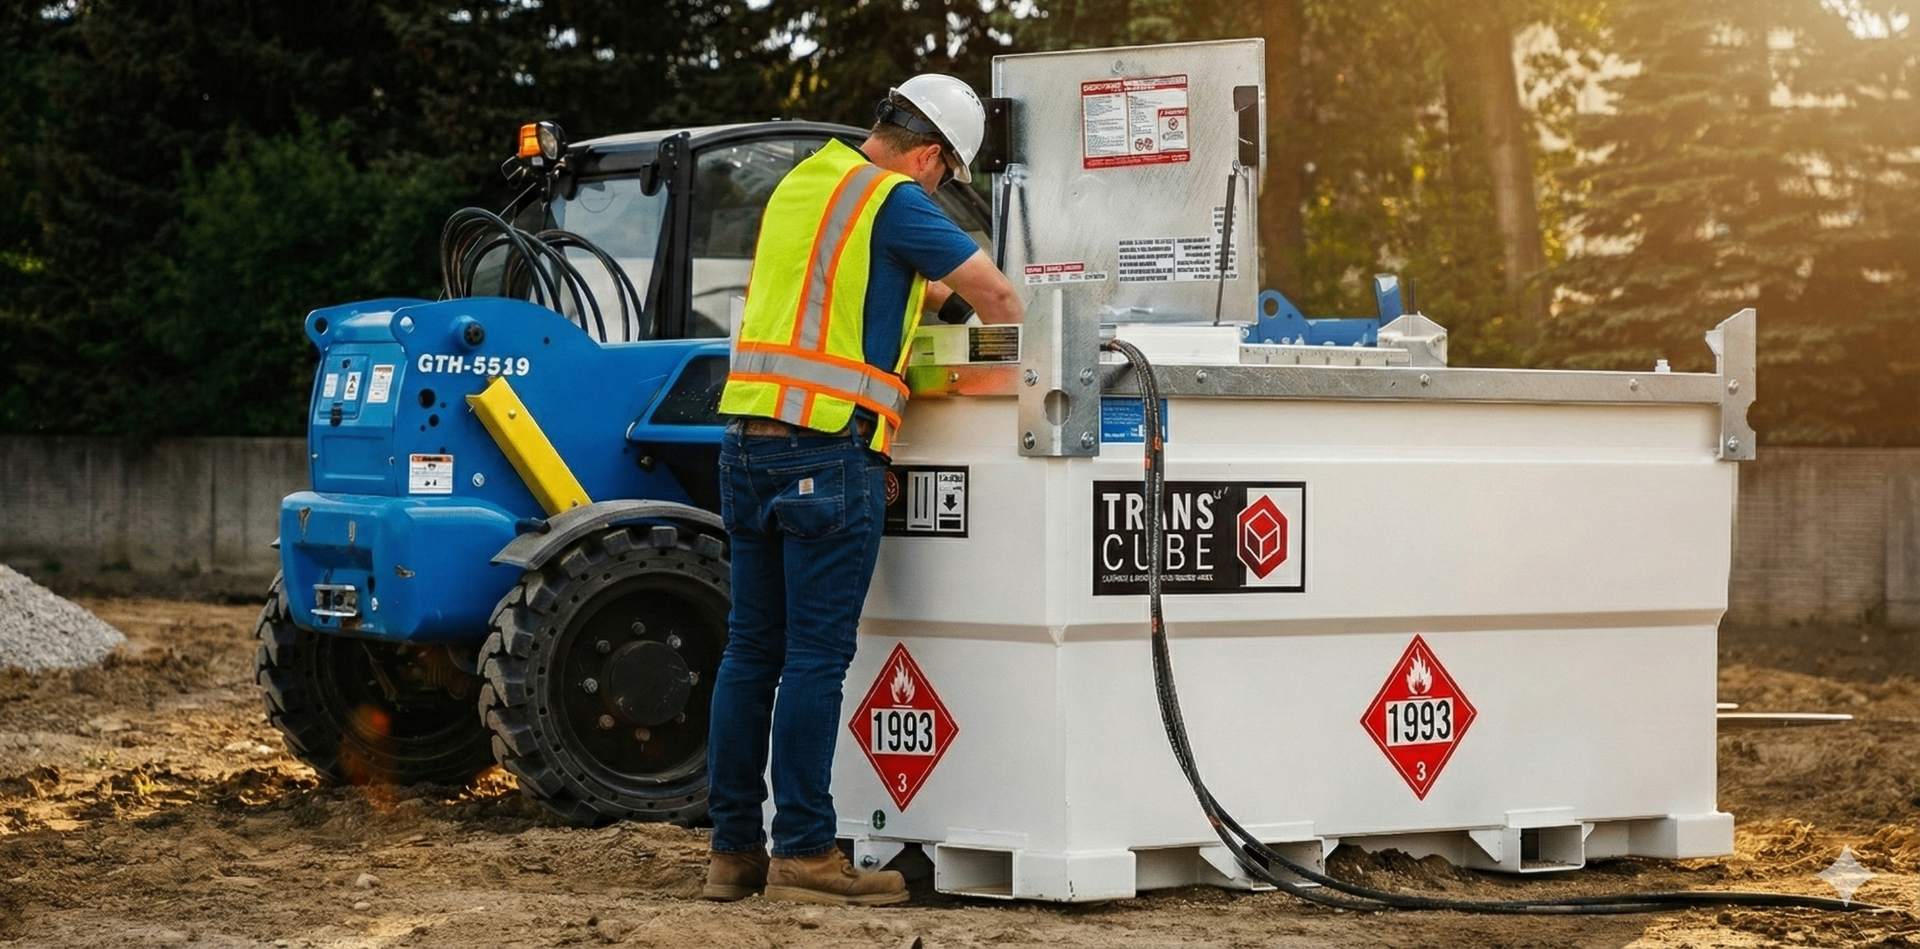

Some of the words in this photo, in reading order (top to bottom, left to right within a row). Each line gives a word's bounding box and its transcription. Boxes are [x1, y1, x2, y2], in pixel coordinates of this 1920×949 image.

[418, 353, 530, 377] GTH-5519
[1102, 492, 1215, 531] TRNS
[873, 710, 933, 753] 1993
[1388, 699, 1451, 743] 1993
[898, 772, 908, 793] 3
[1416, 761, 1427, 781] 3
